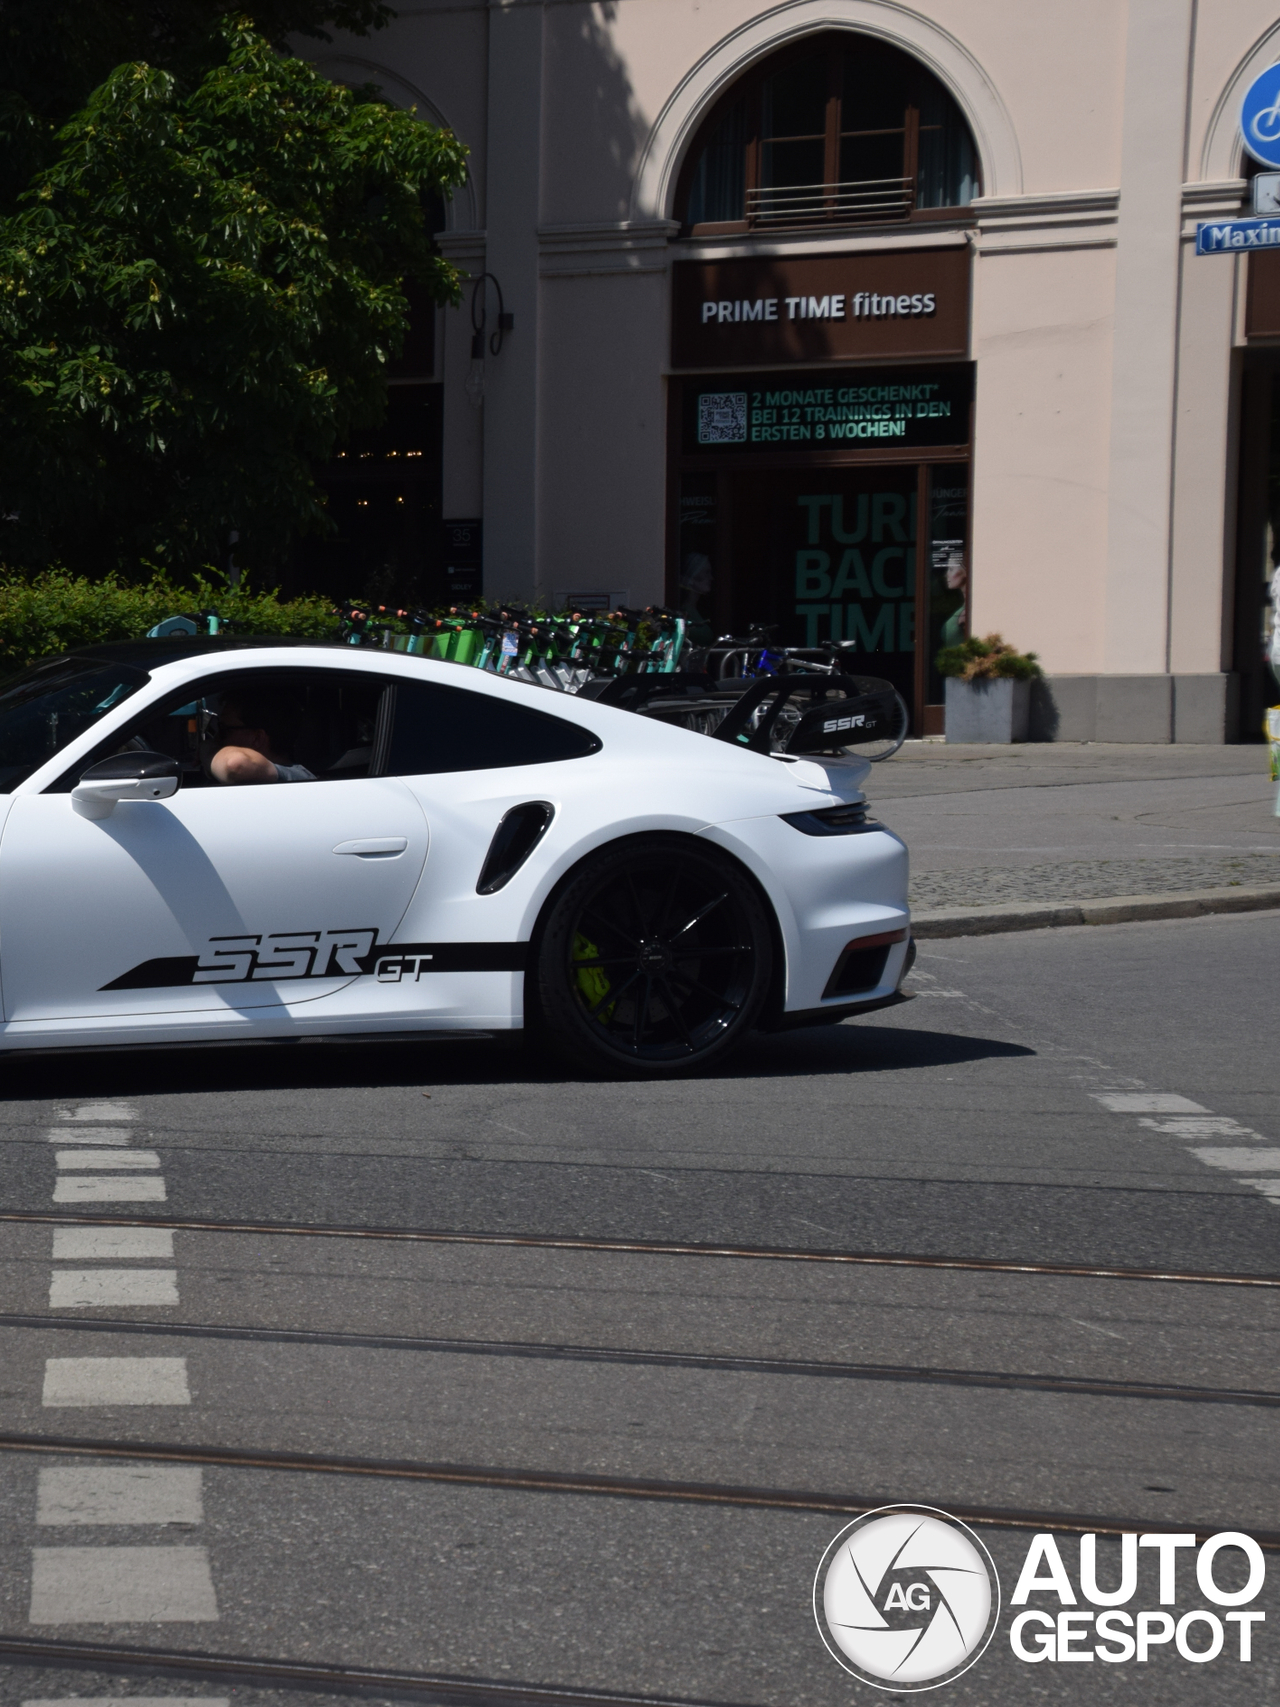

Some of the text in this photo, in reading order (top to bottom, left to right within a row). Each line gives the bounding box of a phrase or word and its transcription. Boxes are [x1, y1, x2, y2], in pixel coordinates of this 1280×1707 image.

[702, 292, 935, 323] PRIME TIME fitness
[752, 392, 762, 407] 2
[765, 388, 834, 406] MONATE
[751, 400, 951, 424] BEI 12 TRAININGS IN DEN
[751, 420, 906, 442] ERSTEN 8 WOCHEN!
[797, 492, 916, 545] TUR
[452, 528, 471, 542] 35
[795, 547, 916, 600] BAC
[823, 714, 878, 733] SSR GT
[192, 928, 433, 984] SSR GT
